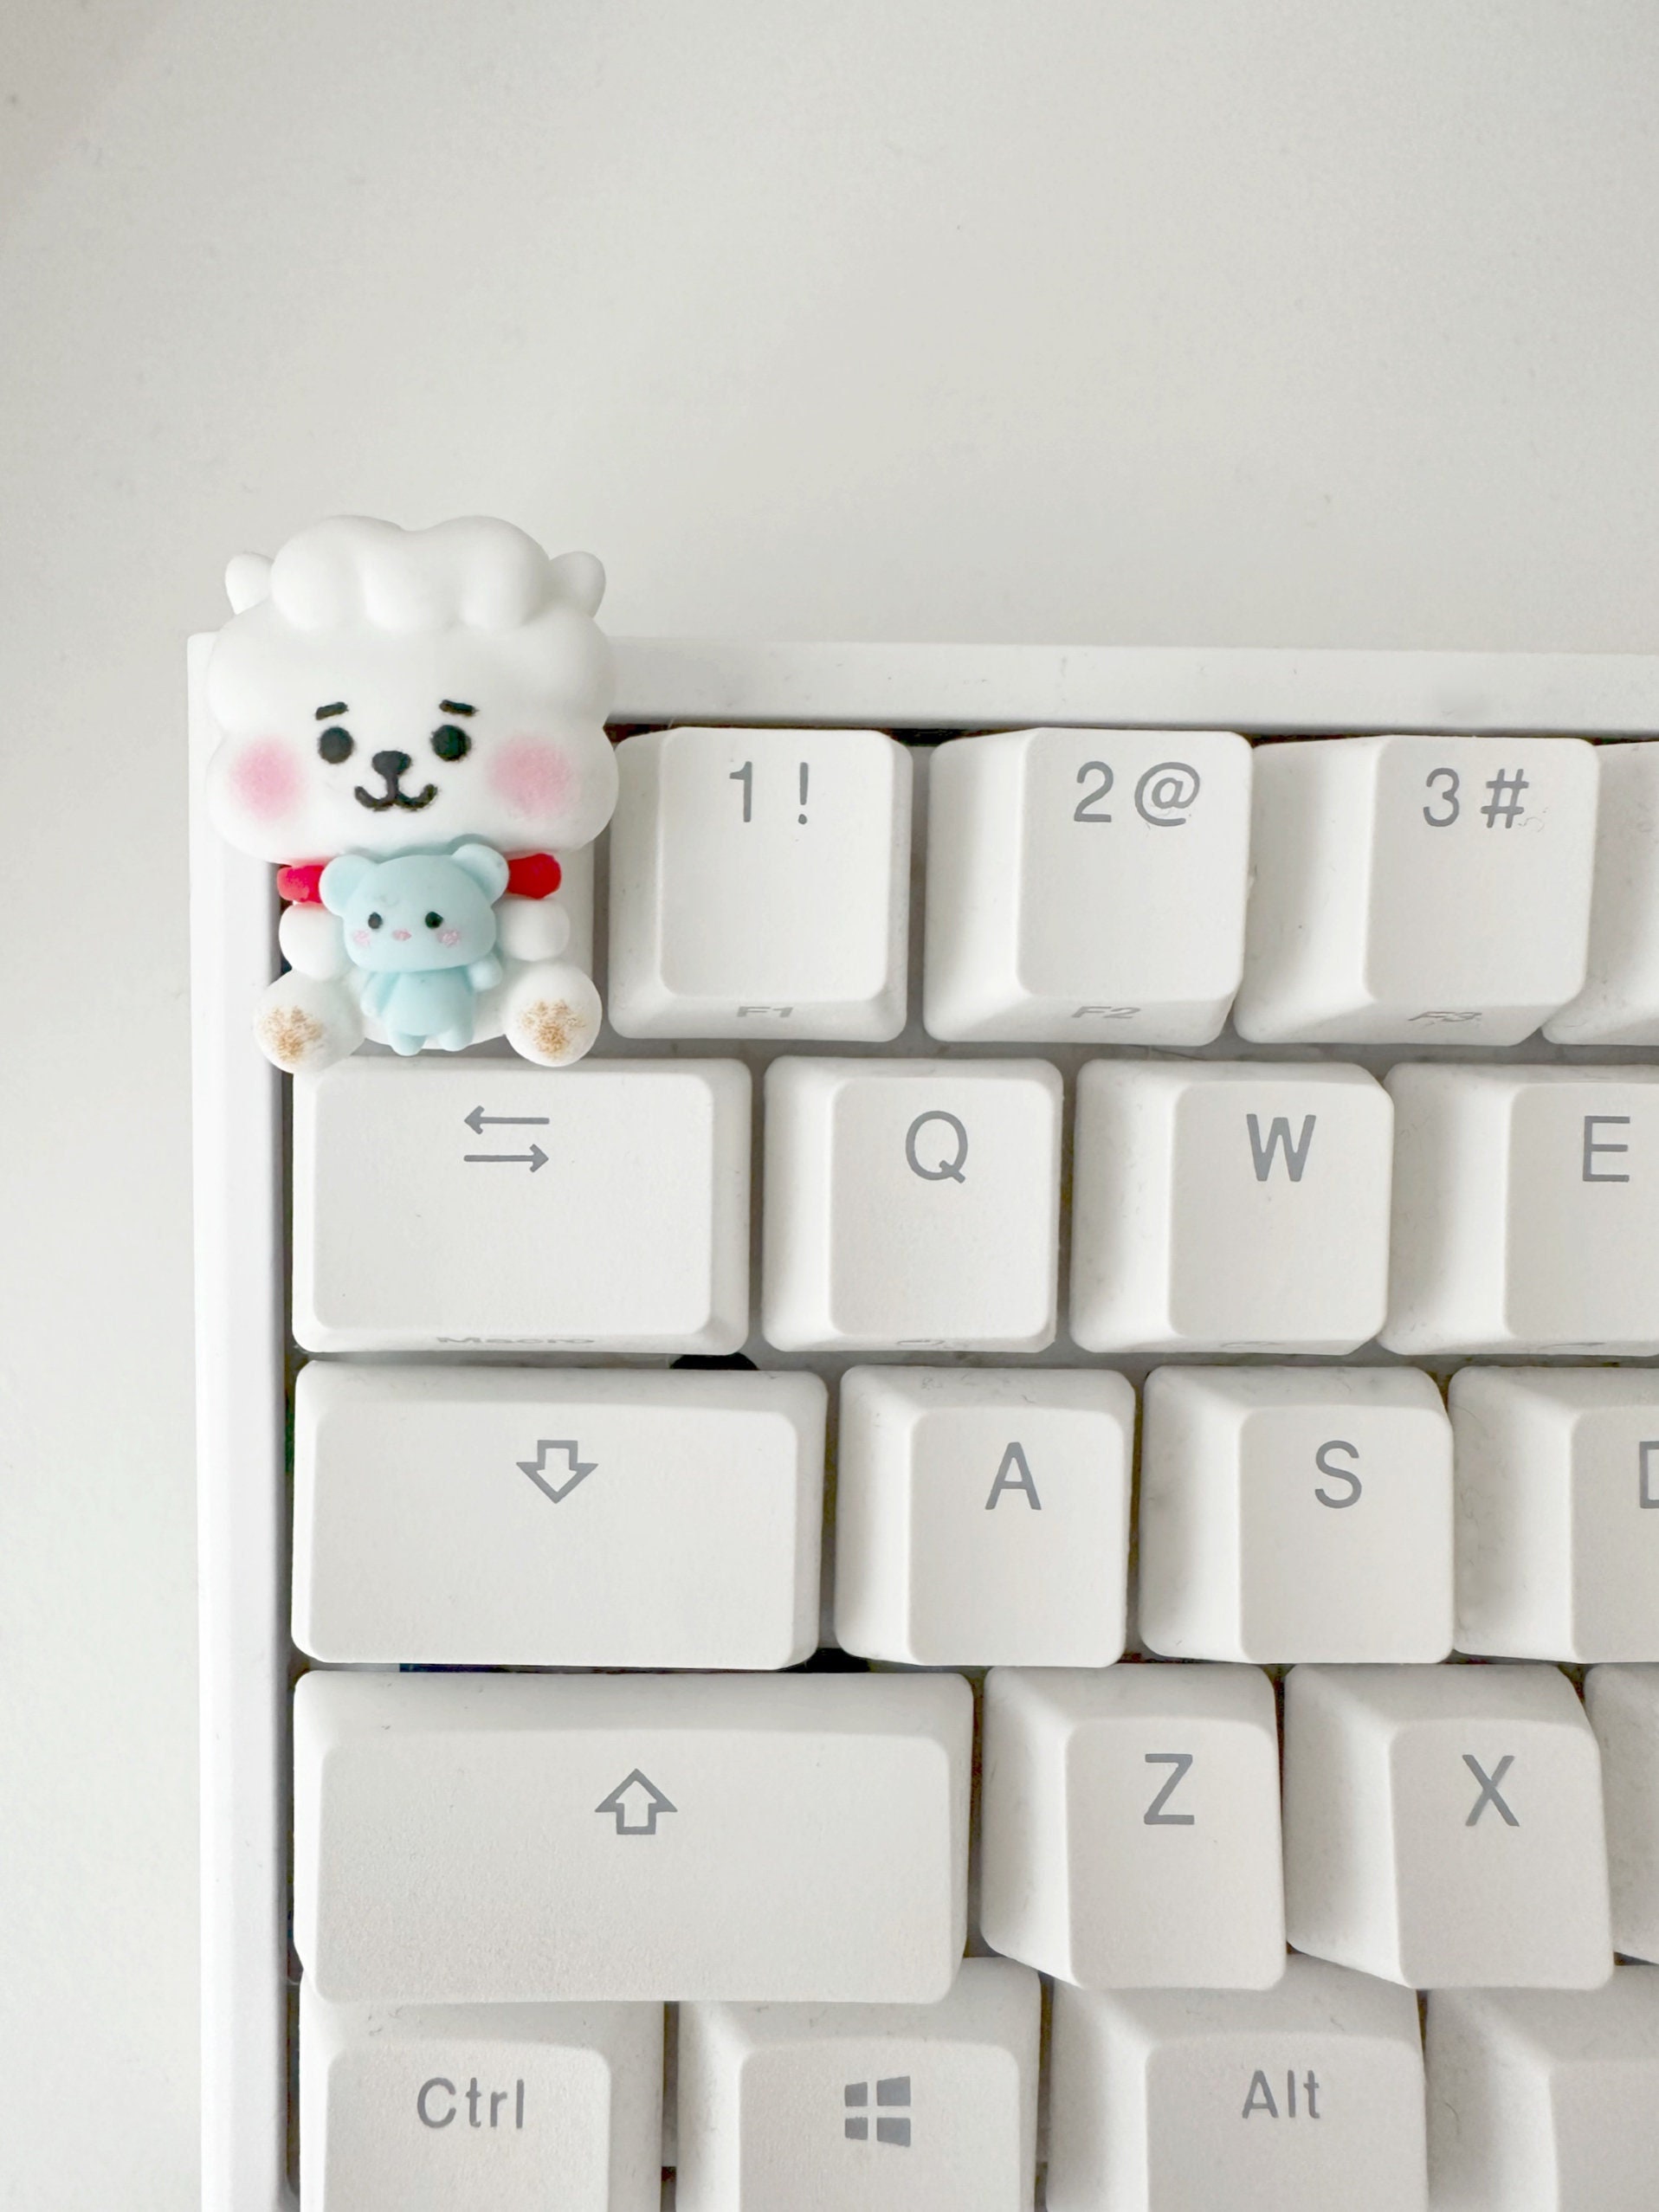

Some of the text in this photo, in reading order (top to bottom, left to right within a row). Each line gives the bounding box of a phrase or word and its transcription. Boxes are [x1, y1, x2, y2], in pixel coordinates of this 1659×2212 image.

[736, 1005, 794, 1019] F1
[1070, 1005, 1141, 1020] F2
[1407, 1010, 1482, 1023] F3
[905, 1110, 969, 1184] Q
[1245, 1112, 1317, 1183] W
[1581, 1115, 1631, 1183] E
[984, 1441, 1043, 1511] A
[1314, 1440, 1363, 1510] S
[1143, 1752, 1195, 1826] Z
[1462, 1754, 1520, 1828] X
[416, 2076, 526, 2131] Ctrl
[1241, 2068, 1321, 2120] Alt
